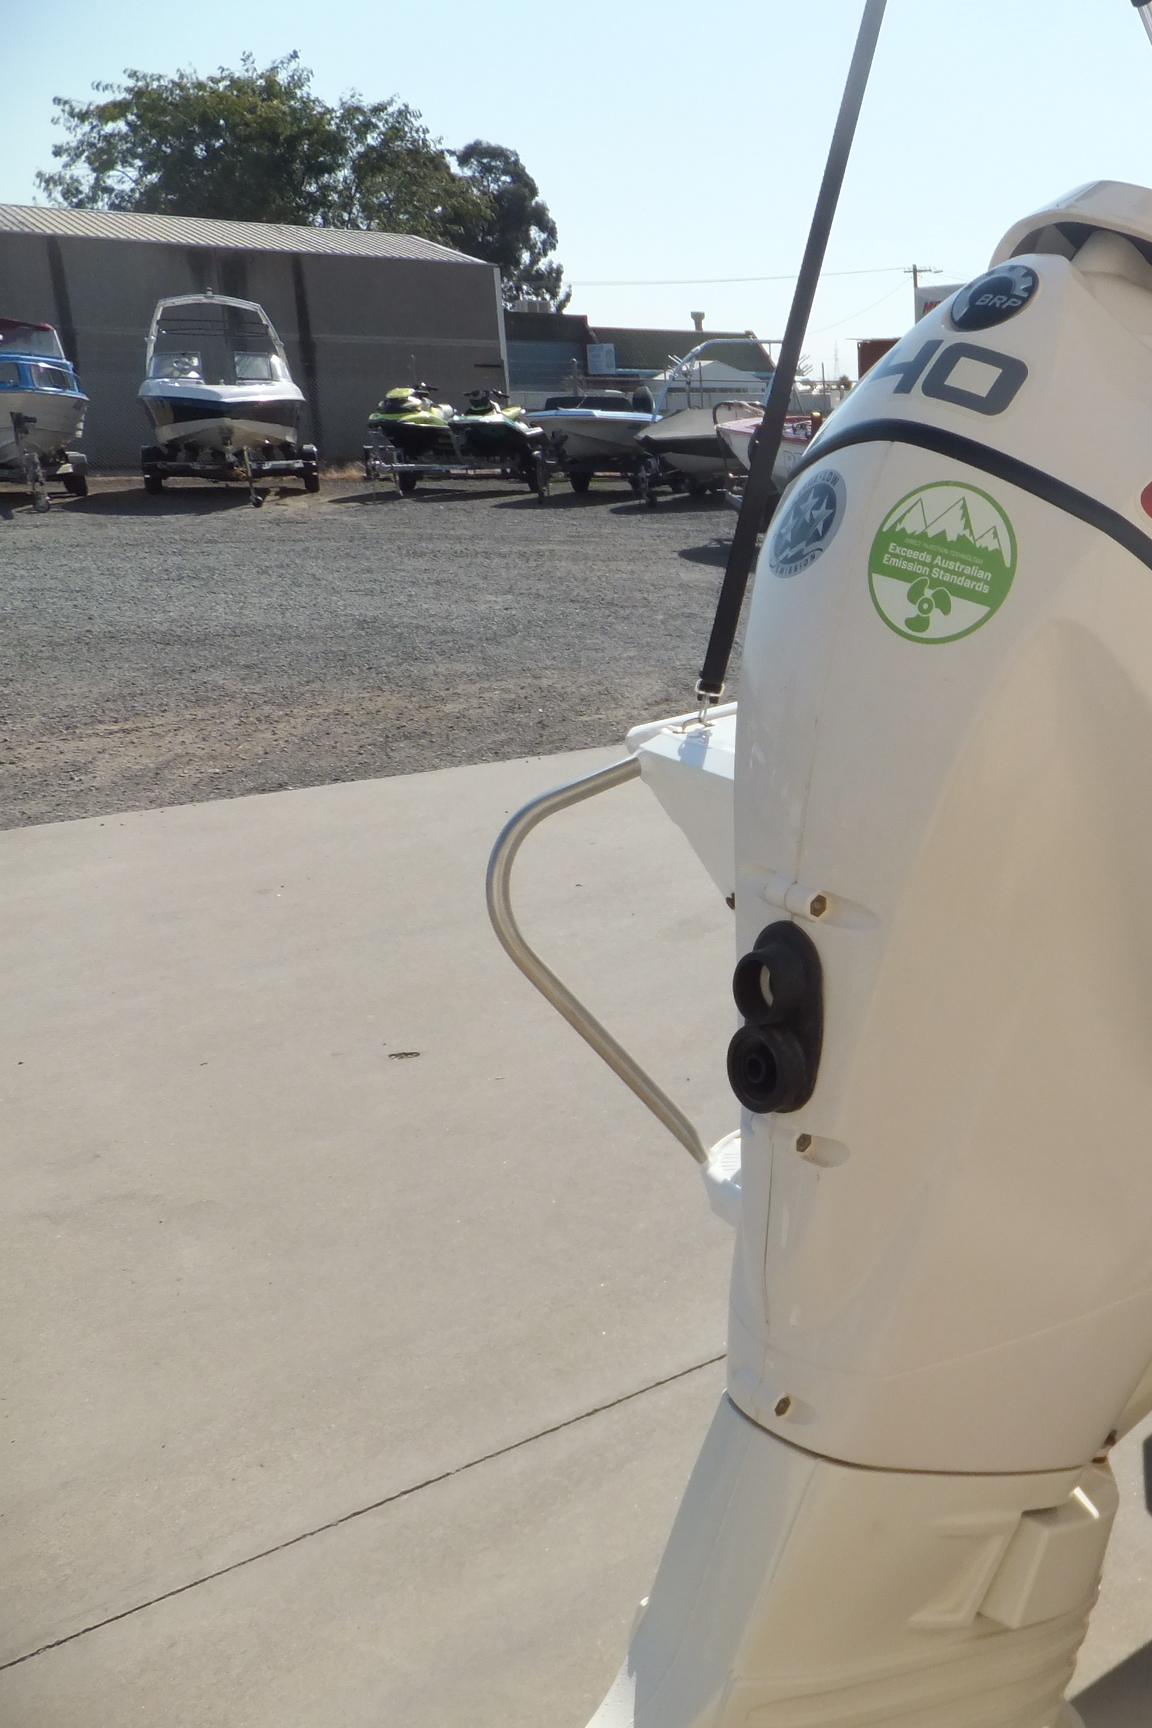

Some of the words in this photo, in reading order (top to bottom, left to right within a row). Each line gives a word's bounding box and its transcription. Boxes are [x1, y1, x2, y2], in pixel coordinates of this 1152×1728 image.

[975, 293, 1022, 309] BRP
[883, 553, 930, 575] Emission
[931, 567, 990, 594] Standards
[888, 542, 932, 563] Exceeds
[933, 555, 992, 581] Australian
